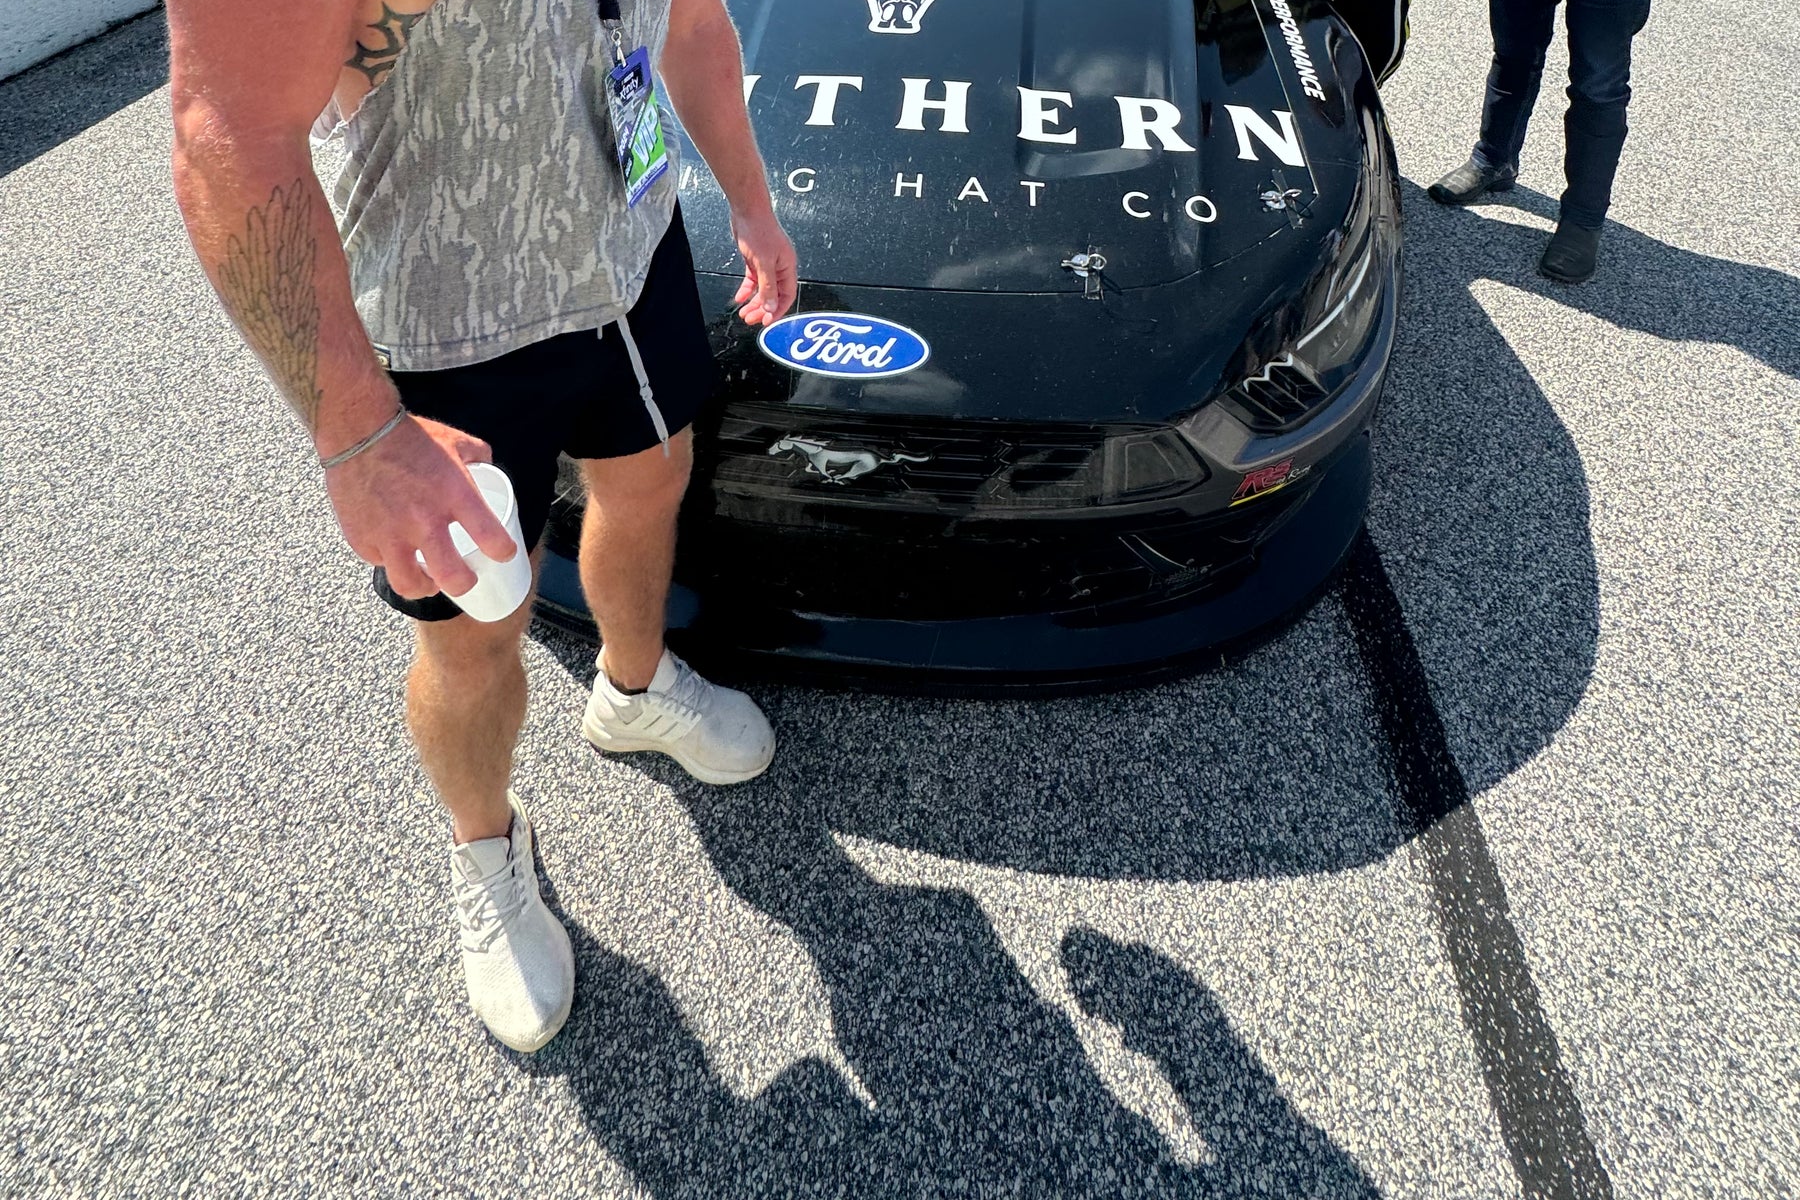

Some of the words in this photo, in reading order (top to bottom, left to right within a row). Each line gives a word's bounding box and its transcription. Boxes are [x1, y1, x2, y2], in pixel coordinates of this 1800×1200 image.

[634, 104, 658, 168] VIP
[894, 172, 1046, 207] HAT
[1121, 190, 1219, 224] CO
[788, 317, 898, 369] Ford
